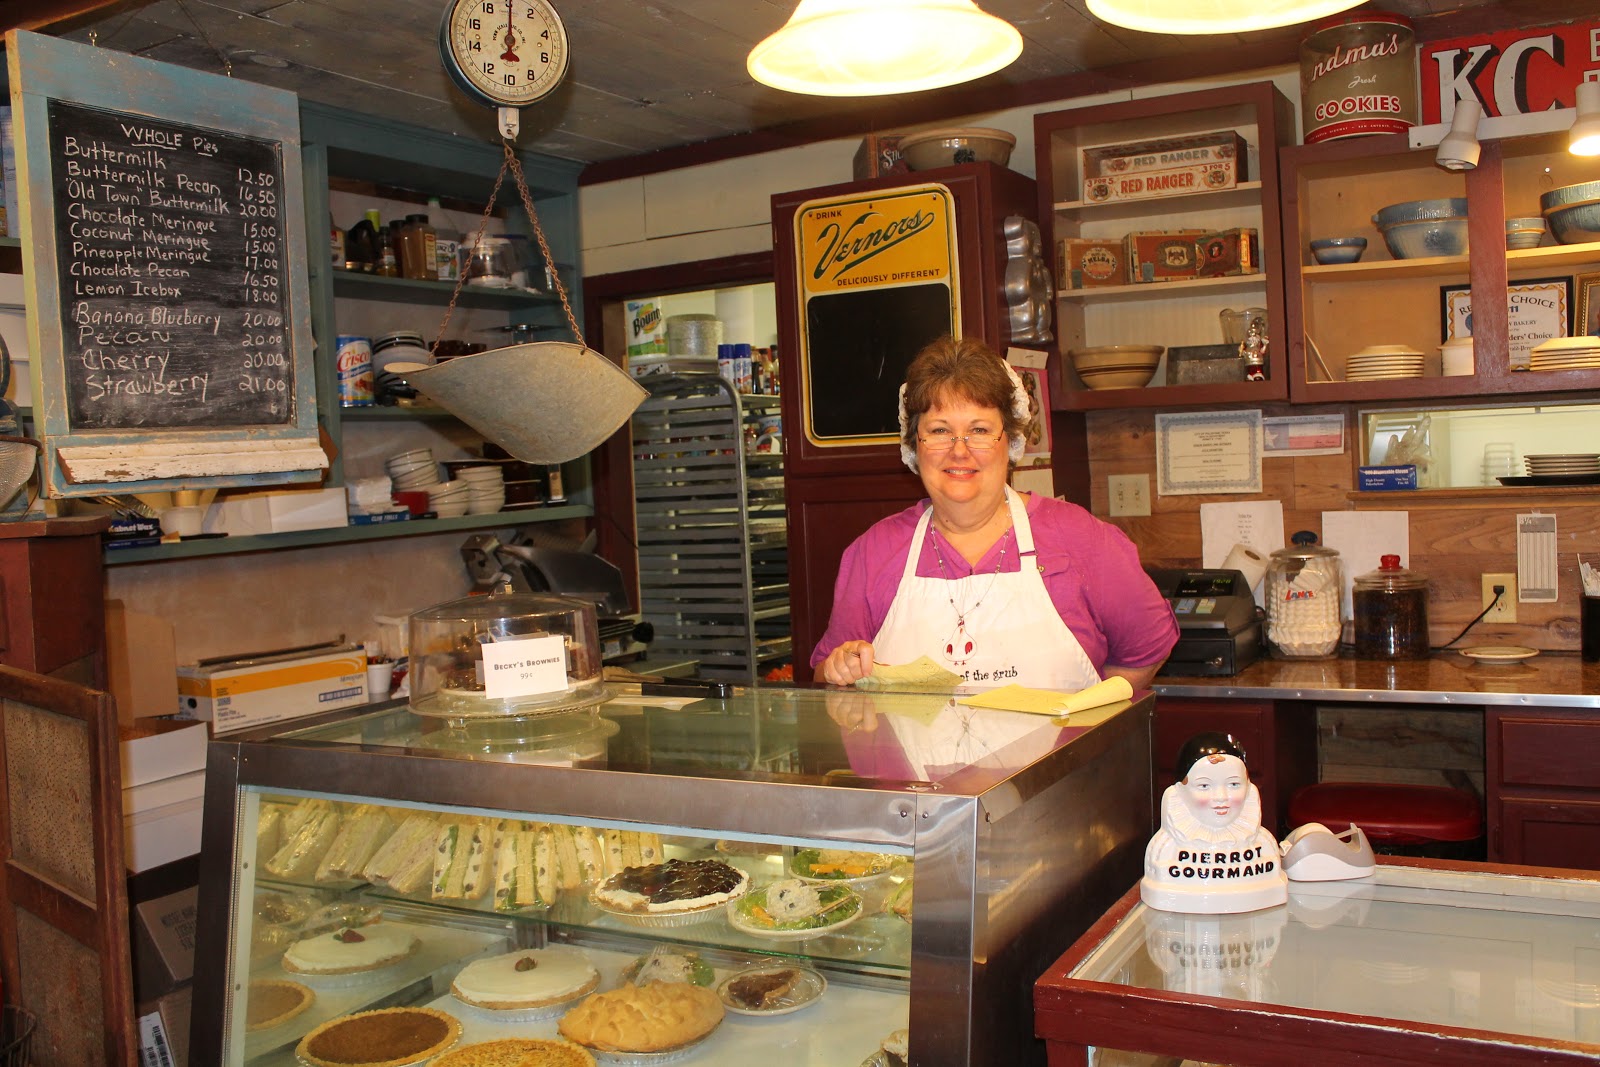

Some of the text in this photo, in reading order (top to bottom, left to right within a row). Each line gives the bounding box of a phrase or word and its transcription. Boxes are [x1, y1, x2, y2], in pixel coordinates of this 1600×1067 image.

[482, 2, 494, 14] 18
[527, 8, 535, 19] 2
[469, 18, 481, 30] 16
[540, 29, 549, 40] 4
[469, 40, 481, 52] 14
[540, 52, 549, 63] 6
[483, 62, 495, 75] 12
[527, 69, 535, 80] 8
[504, 74, 516, 86] 10
[1432, 35, 1560, 124] KC
[1315, 94, 1401, 121] COOKIES
[121, 123, 219, 154] WHOLE Pies
[64, 136, 275, 187] Buttermilk 12.50
[1133, 149, 1210, 167] RED RANGER
[1202, 162, 1231, 173] 3 FOR 5
[67, 160, 276, 204] Buttermilk Pecan 16.50
[1087, 180, 1093, 188] 3
[1108, 177, 1114, 185] 5
[1120, 172, 1194, 194] RED RANGER
[149, 188, 231, 215] Buttermilk
[239, 203, 277, 218] 20.00
[67, 202, 277, 239] Chocolate Meringue 15.00
[816, 209, 843, 220] DRINK
[70, 221, 276, 254] Coconut Meringue 15.00
[813, 208, 935, 280] Vernors
[72, 241, 278, 271] Pineapple Meringue 17.00
[70, 261, 279, 288] Chocolate Pecan 16.50
[837, 268, 941, 287] DELICIOUSLY DIFFERENT
[75, 280, 278, 304] Lemon Icebox 18.00
[1510, 294, 1556, 309] CHOICE
[151, 306, 221, 336] Blueberry
[242, 312, 282, 329] 20.00
[1513, 319, 1537, 327] BAKERY
[79, 325, 283, 348] Pecan 20.00
[1508, 331, 1553, 341] ders' Choice
[82, 348, 286, 383] Cherry 20.00
[336, 351, 370, 373] Crisco
[85, 371, 287, 403] Strawberry 21.00
[494, 656, 560, 671] BECKY'S BROWNIES
[972, 669, 989, 681] the
[992, 665, 1018, 681] grub
[1178, 846, 1262, 864] PIERROT
[1168, 861, 1275, 879] GOURMAND
